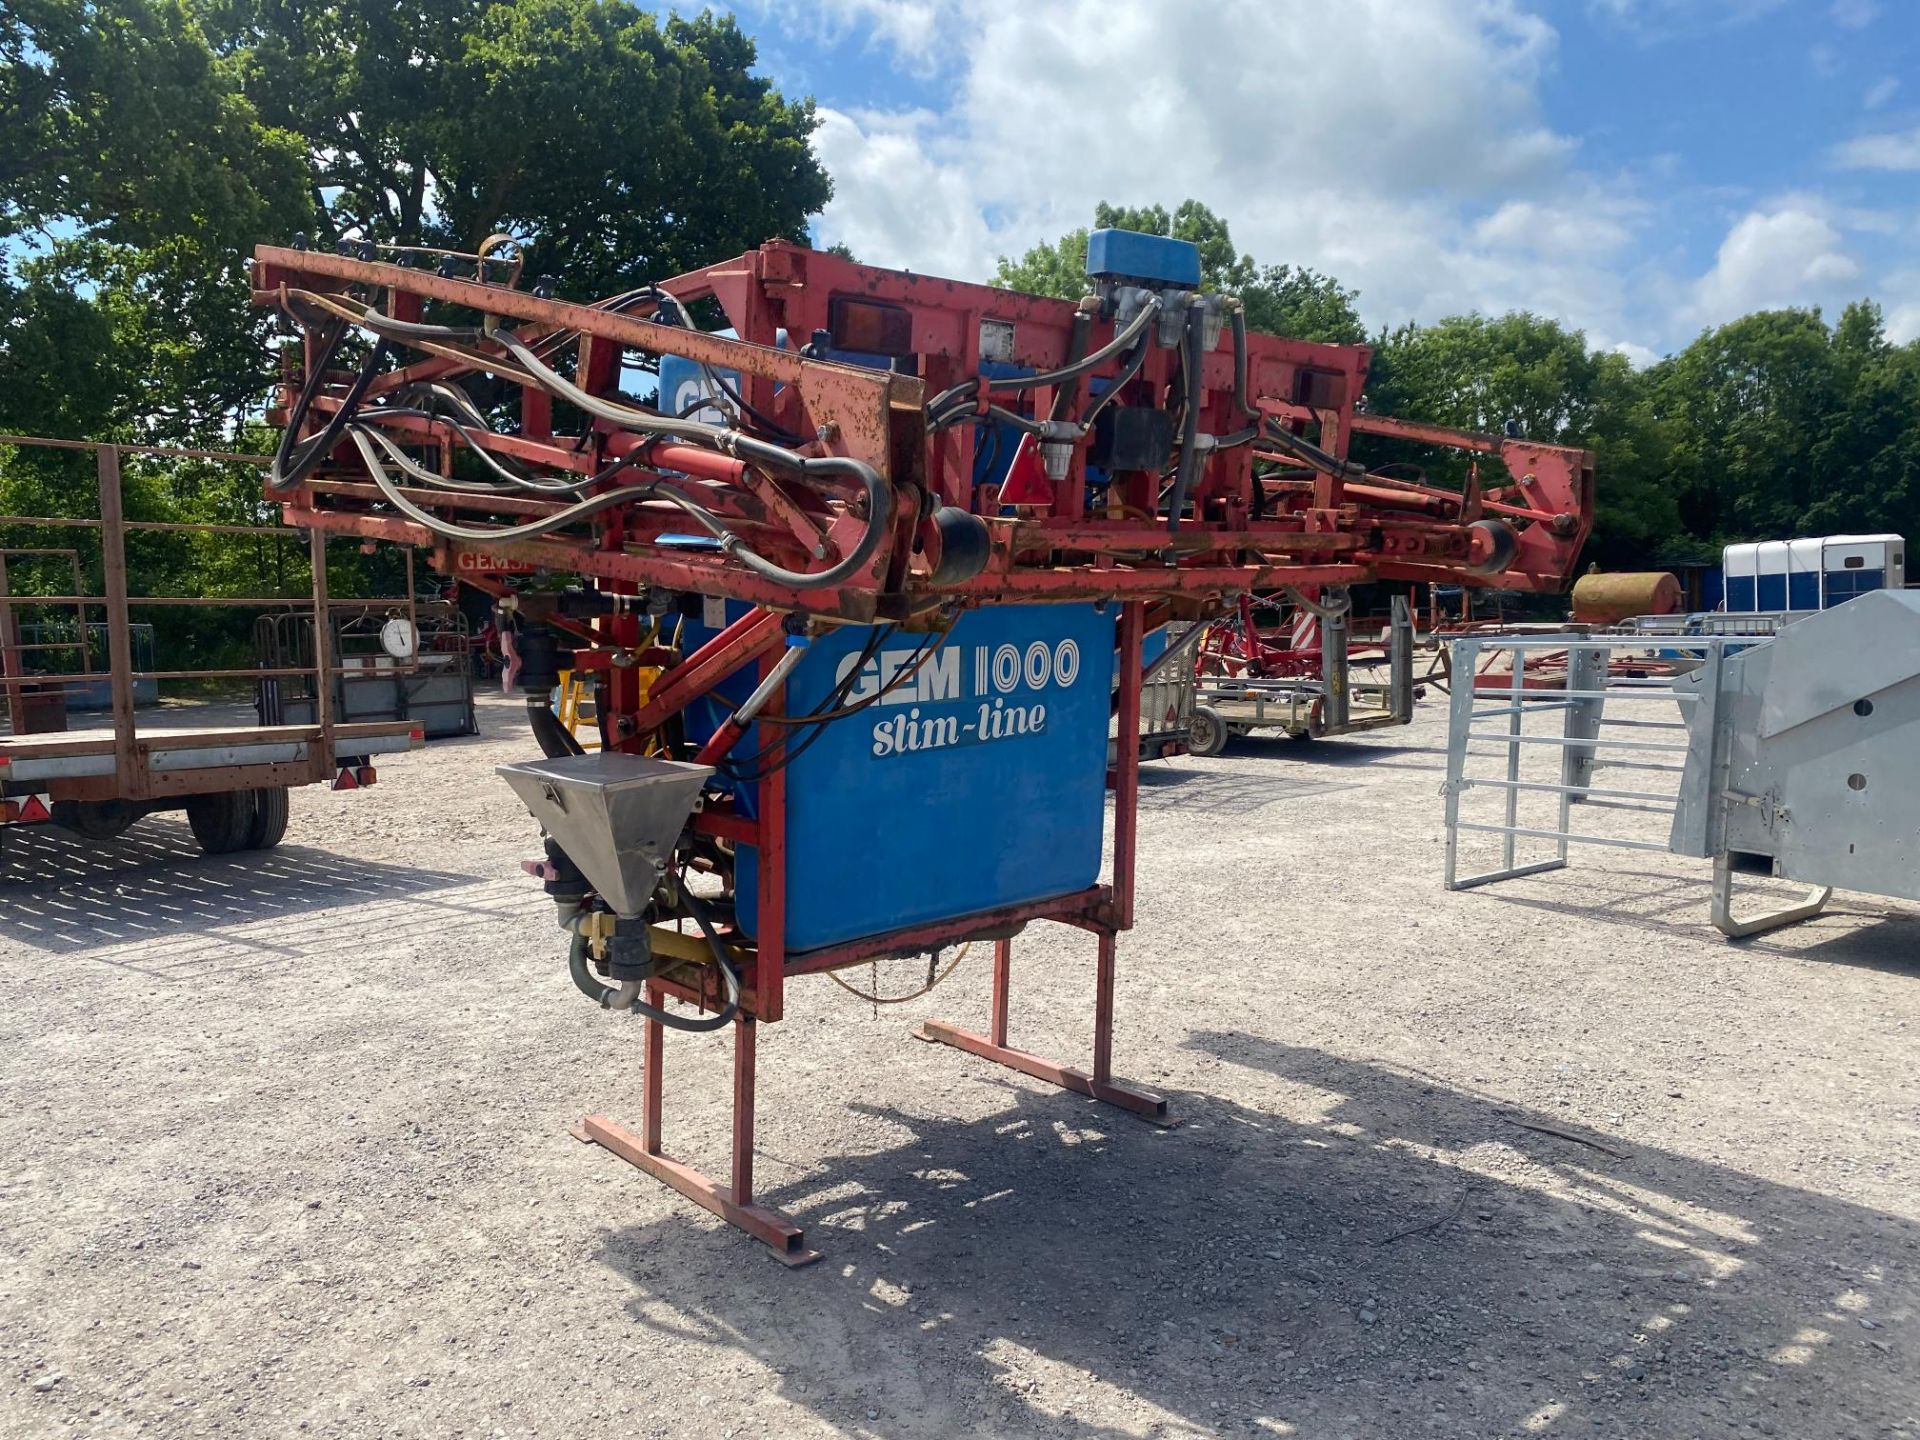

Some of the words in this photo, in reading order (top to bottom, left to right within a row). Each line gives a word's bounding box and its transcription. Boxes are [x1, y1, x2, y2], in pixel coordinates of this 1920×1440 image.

[835, 645, 961, 707] GEM
[974, 638, 1080, 697] 1000
[872, 697, 1046, 757] slim-line
